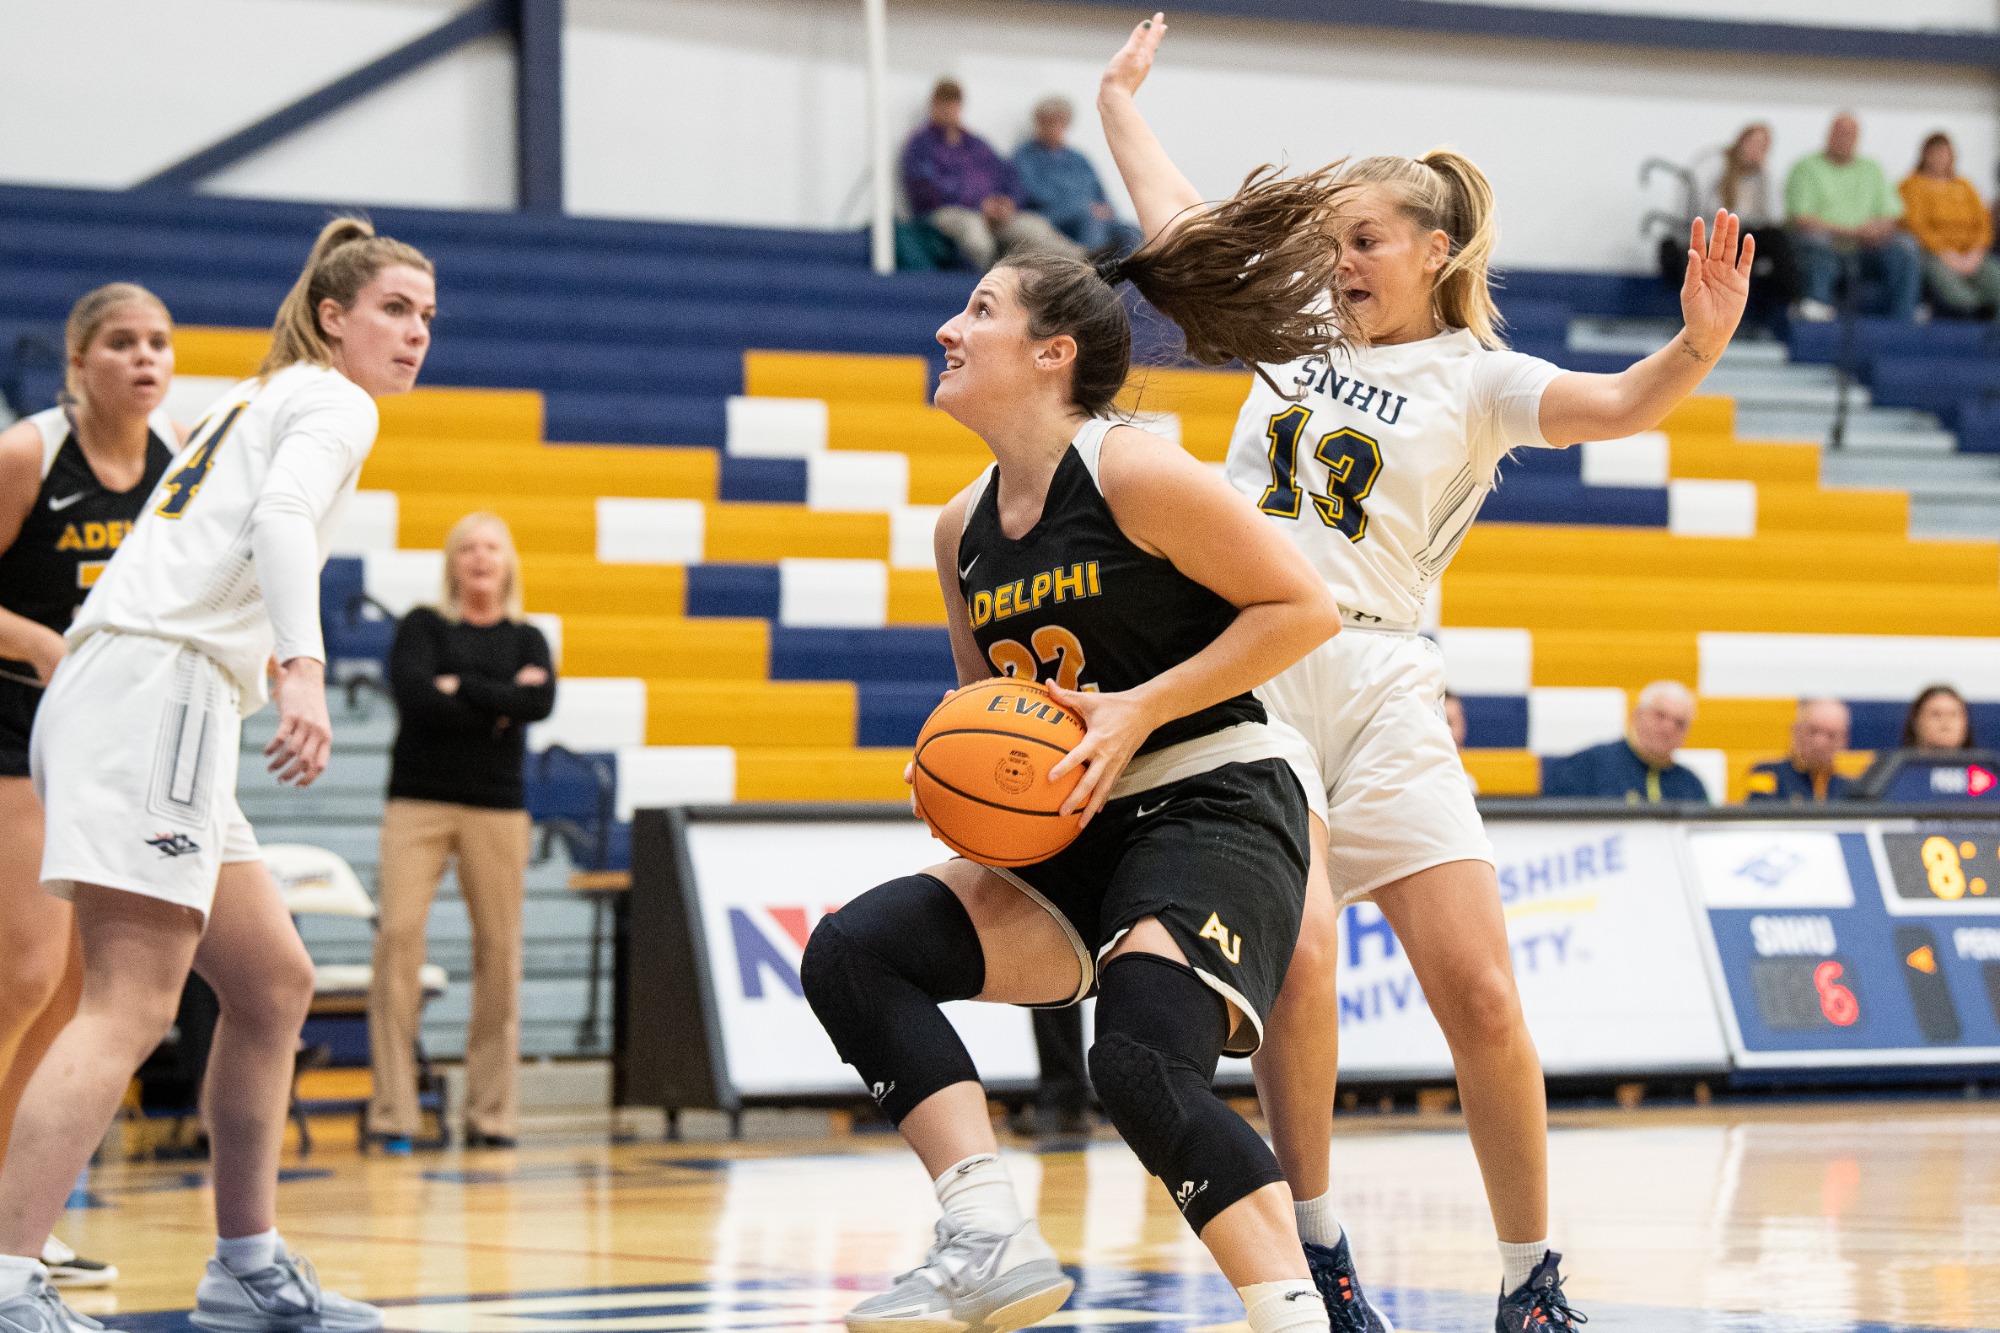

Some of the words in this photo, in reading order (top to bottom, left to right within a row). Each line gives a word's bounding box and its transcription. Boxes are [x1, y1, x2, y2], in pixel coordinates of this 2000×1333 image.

[1293, 357, 1408, 425] SNHU
[1257, 403, 1384, 544] 13
[968, 560, 1102, 631] DELPHI
[986, 695, 1066, 726] EVO
[1199, 911, 1242, 965] AU
[1813, 960, 1860, 1027] 6
